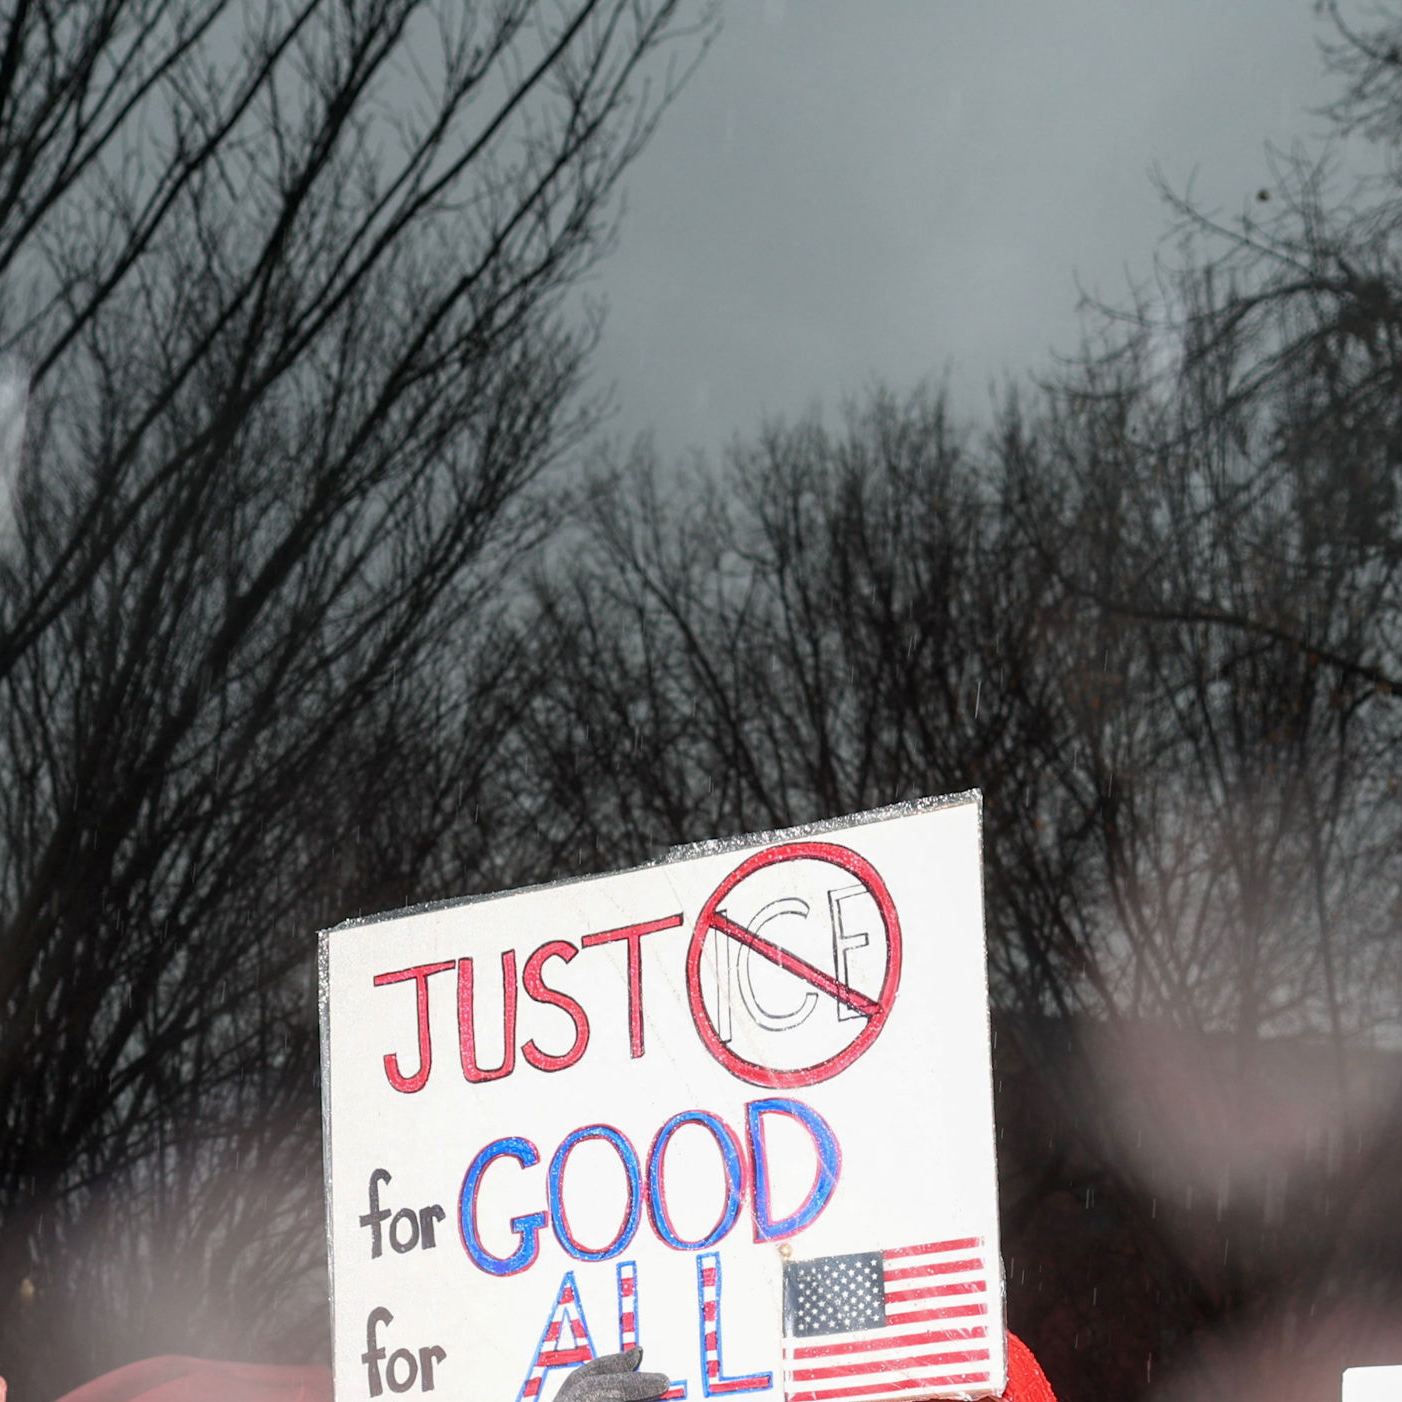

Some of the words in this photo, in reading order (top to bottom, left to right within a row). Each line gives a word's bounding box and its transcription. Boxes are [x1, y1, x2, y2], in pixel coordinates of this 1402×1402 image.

[360, 1169, 446, 1259] for
[459, 1097, 842, 1277] GOOD
[361, 1307, 447, 1397] for
